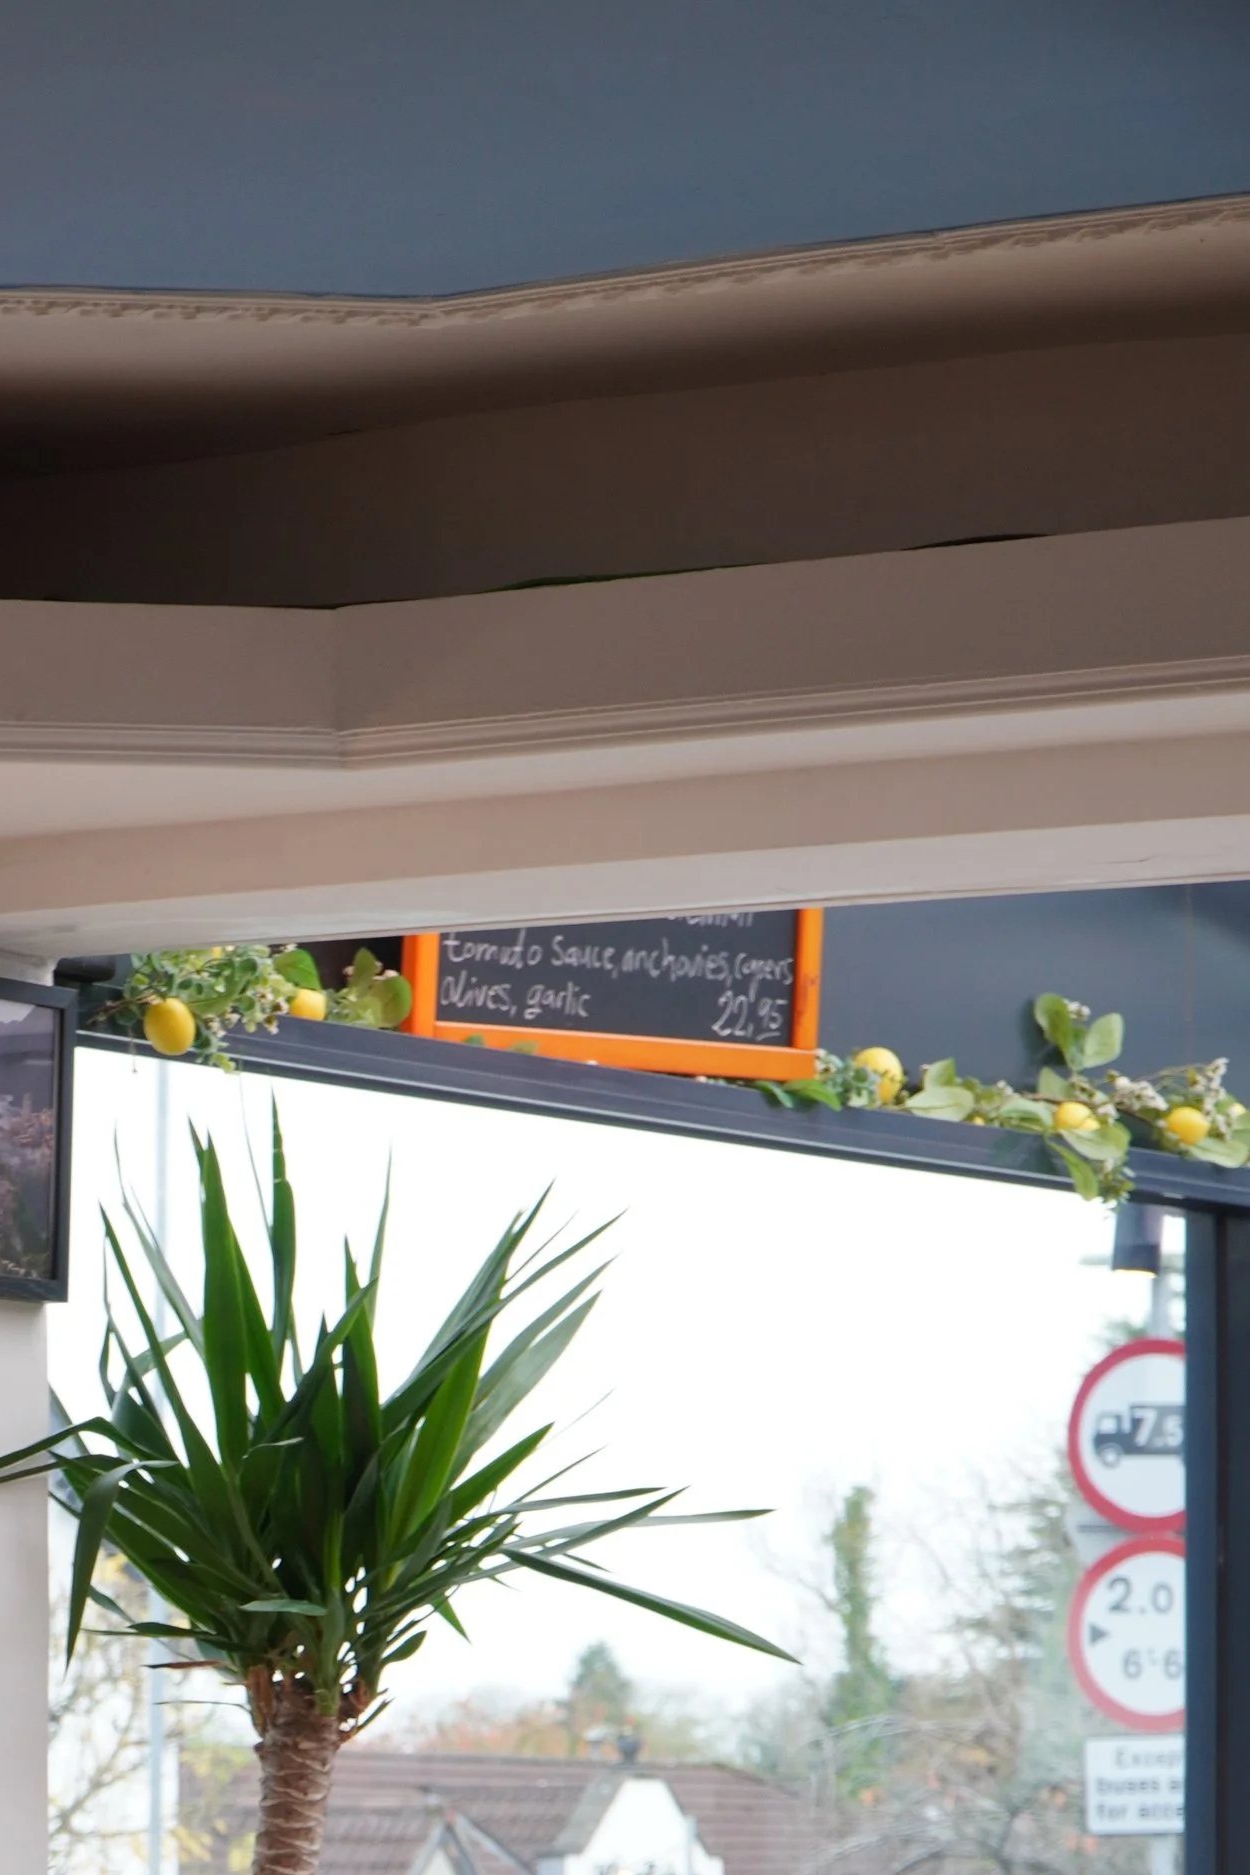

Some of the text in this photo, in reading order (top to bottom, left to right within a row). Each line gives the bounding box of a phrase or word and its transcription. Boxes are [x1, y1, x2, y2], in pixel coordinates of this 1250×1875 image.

[523, 981, 591, 1020] garlic
[1132, 1408, 1184, 1447] 7.5
[1107, 1575, 1174, 1615] 2.0
[1114, 1746, 1184, 1770] Excep
[1138, 1804, 1184, 1821] acce
